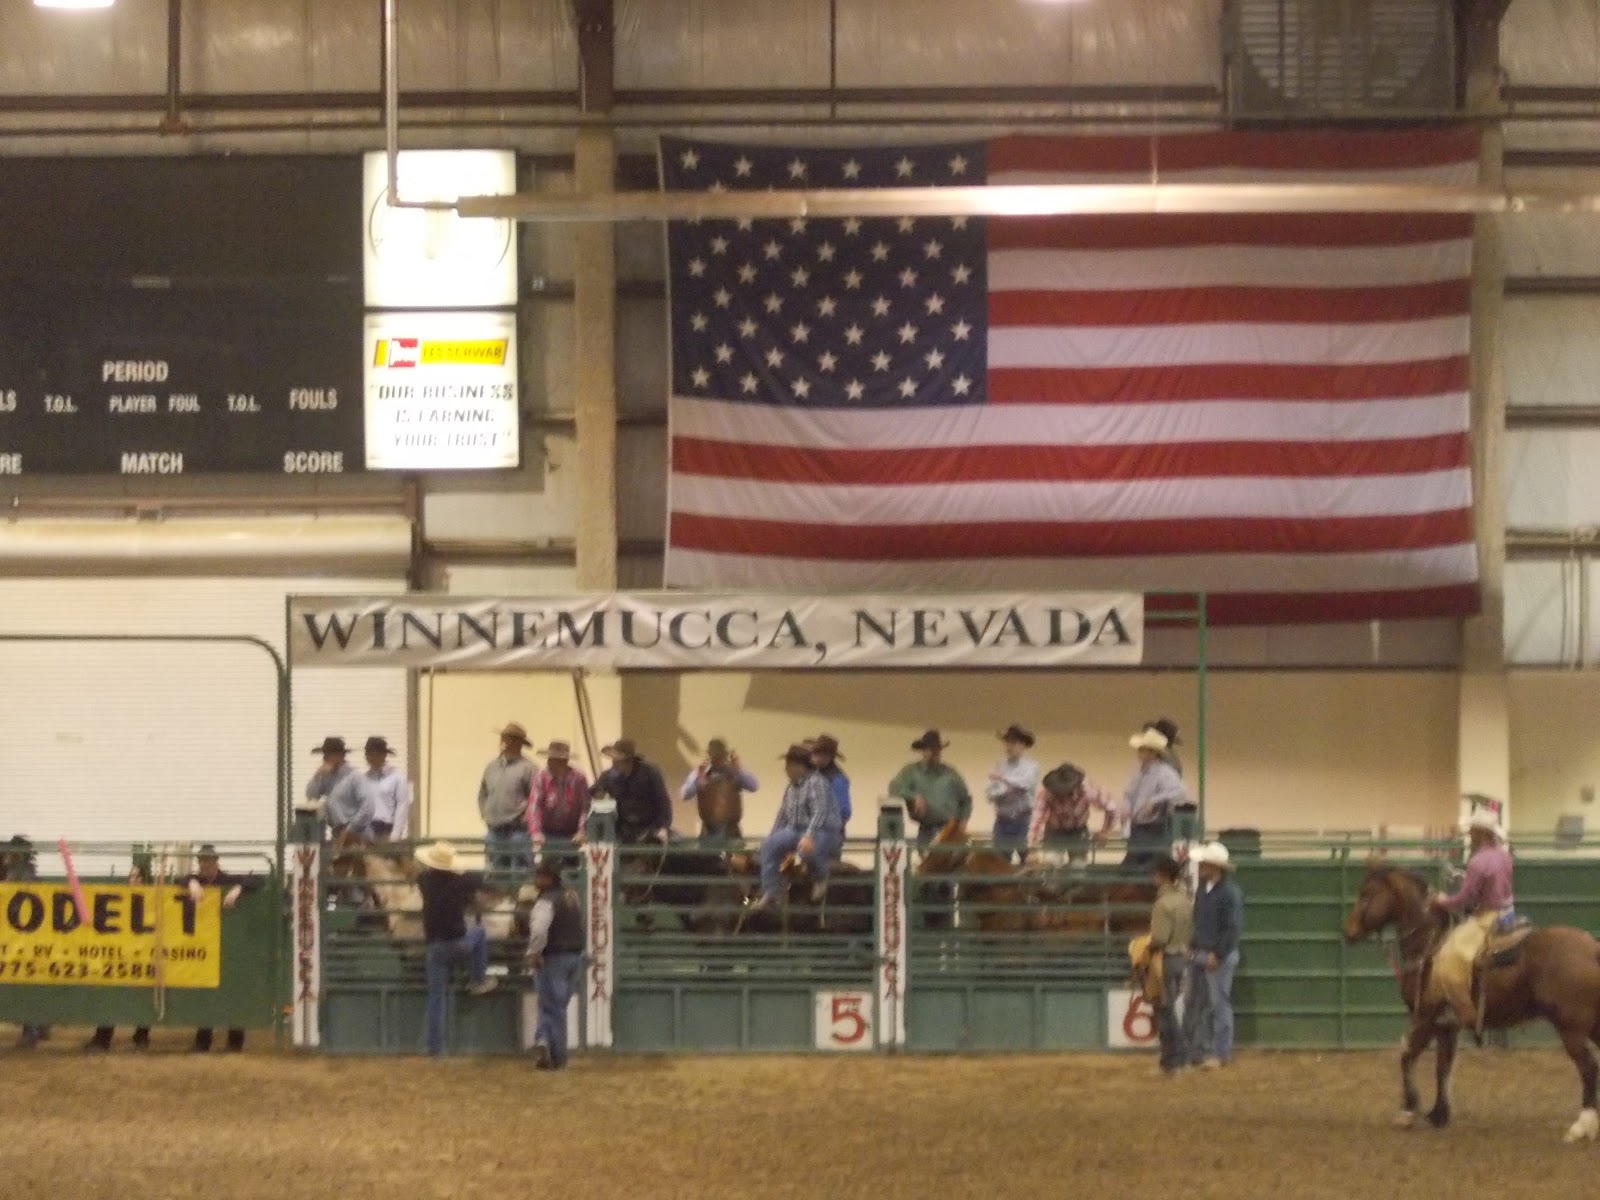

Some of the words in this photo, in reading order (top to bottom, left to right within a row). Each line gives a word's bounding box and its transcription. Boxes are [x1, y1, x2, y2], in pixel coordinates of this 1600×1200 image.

[102, 360, 169, 382] PERIOD
[109, 395, 157, 412] PLAYER
[168, 395, 201, 412] FOUL
[289, 388, 338, 410] FOULS
[120, 452, 184, 474] MATCH
[283, 451, 344, 473] SCORE
[303, 609, 826, 664] WINNEMUCCA,
[850, 606, 1132, 649] NEVADA
[173, 893, 198, 935] T
[79, 945, 123, 959] HOTEL
[831, 997, 868, 1044] 5
[1122, 995, 1158, 1042] 6
